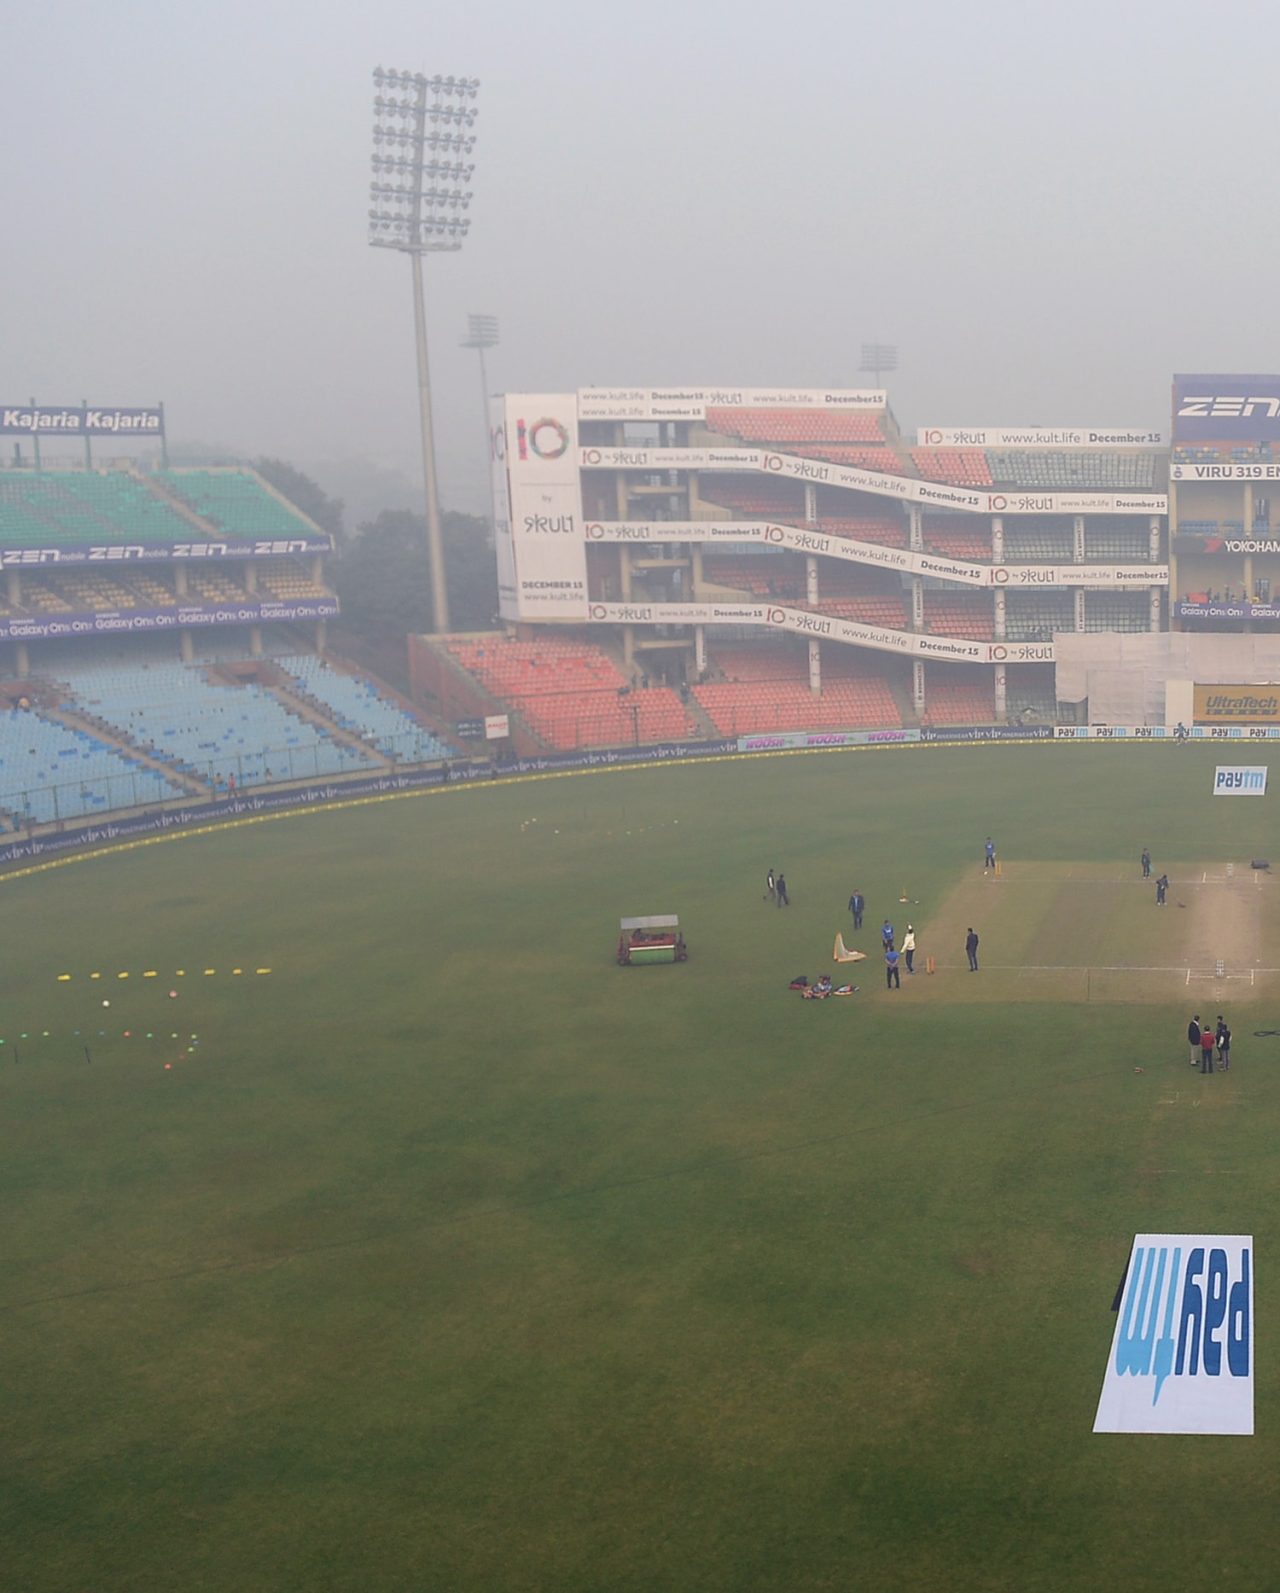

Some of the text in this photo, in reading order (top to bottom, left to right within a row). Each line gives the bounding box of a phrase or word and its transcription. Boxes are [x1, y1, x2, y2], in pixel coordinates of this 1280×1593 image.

[1177, 397, 1280, 417] ZEN
[3, 410, 79, 431] Kajaria
[86, 411, 159, 431] Kajaria
[1002, 432, 1080, 445] www.kult.life
[1089, 433, 1146, 443] December
[1148, 433, 1160, 443] 15
[1195, 466, 1232, 478] VIRU
[1236, 466, 1262, 478] 319
[840, 471, 906, 493] www.kult.life
[919, 487, 967, 504] December
[967, 496, 979, 505] 15
[1116, 500, 1155, 508] December
[841, 543, 906, 566] www.kult.life
[921, 559, 967, 576] December
[969, 569, 981, 578] 15
[842, 626, 907, 647] www.kult.life
[920, 640, 966, 656] December
[967, 647, 979, 656] 15
[1206, 696, 1278, 708] UltraTech
[1173, 727, 1203, 737] pytm
